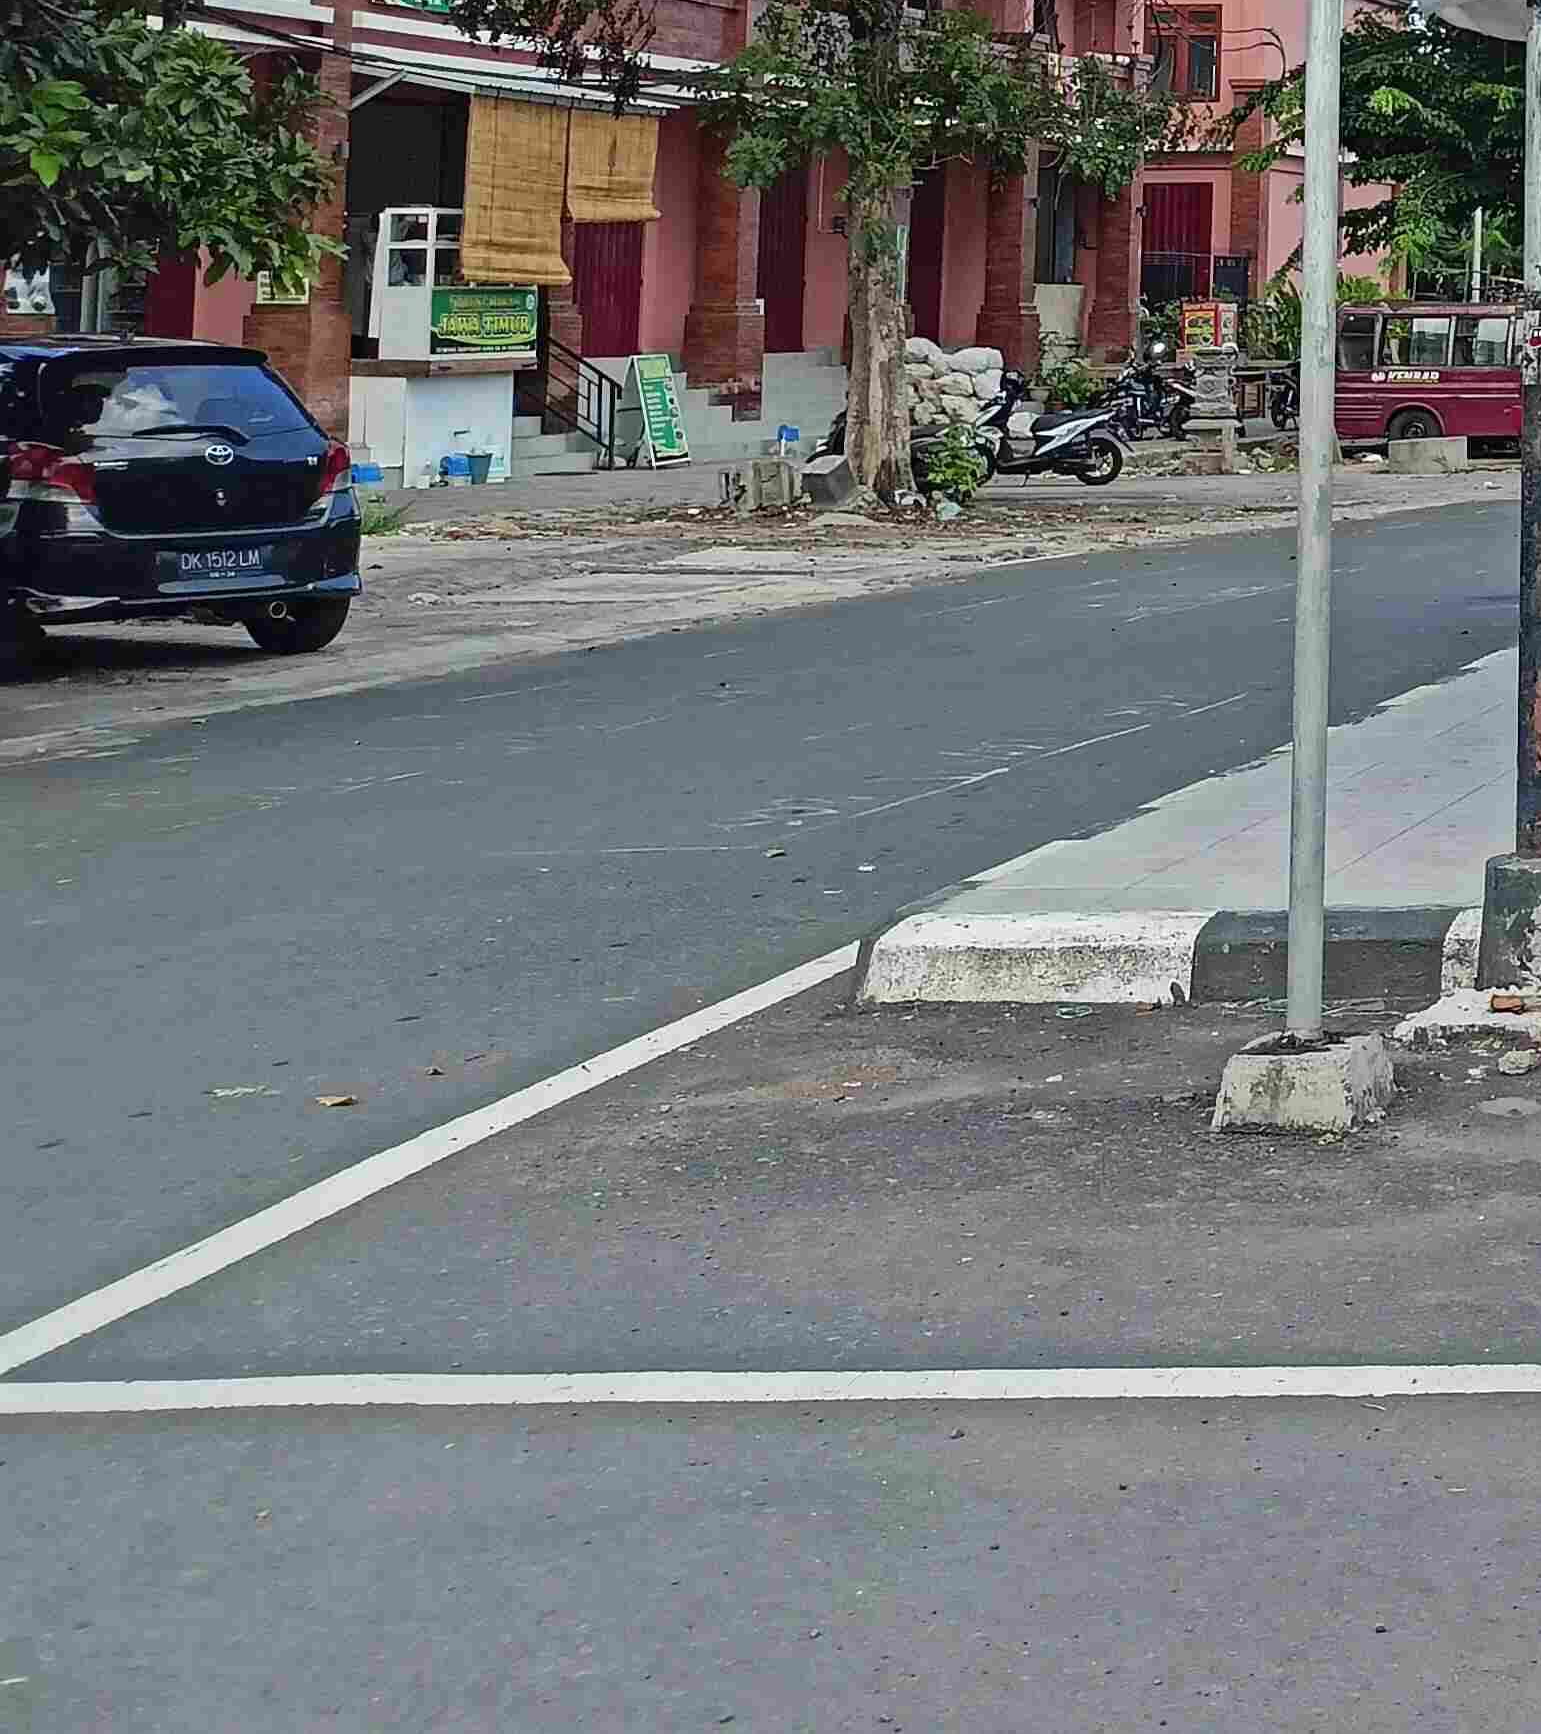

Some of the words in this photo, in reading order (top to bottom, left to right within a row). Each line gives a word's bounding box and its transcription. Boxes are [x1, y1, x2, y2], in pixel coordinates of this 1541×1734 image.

[440, 314, 480, 336] JAWA
[483, 314, 530, 336] TIMUR
[181, 553, 202, 570] DK
[207, 550, 236, 568] 1512
[239, 548, 260, 566] LM
